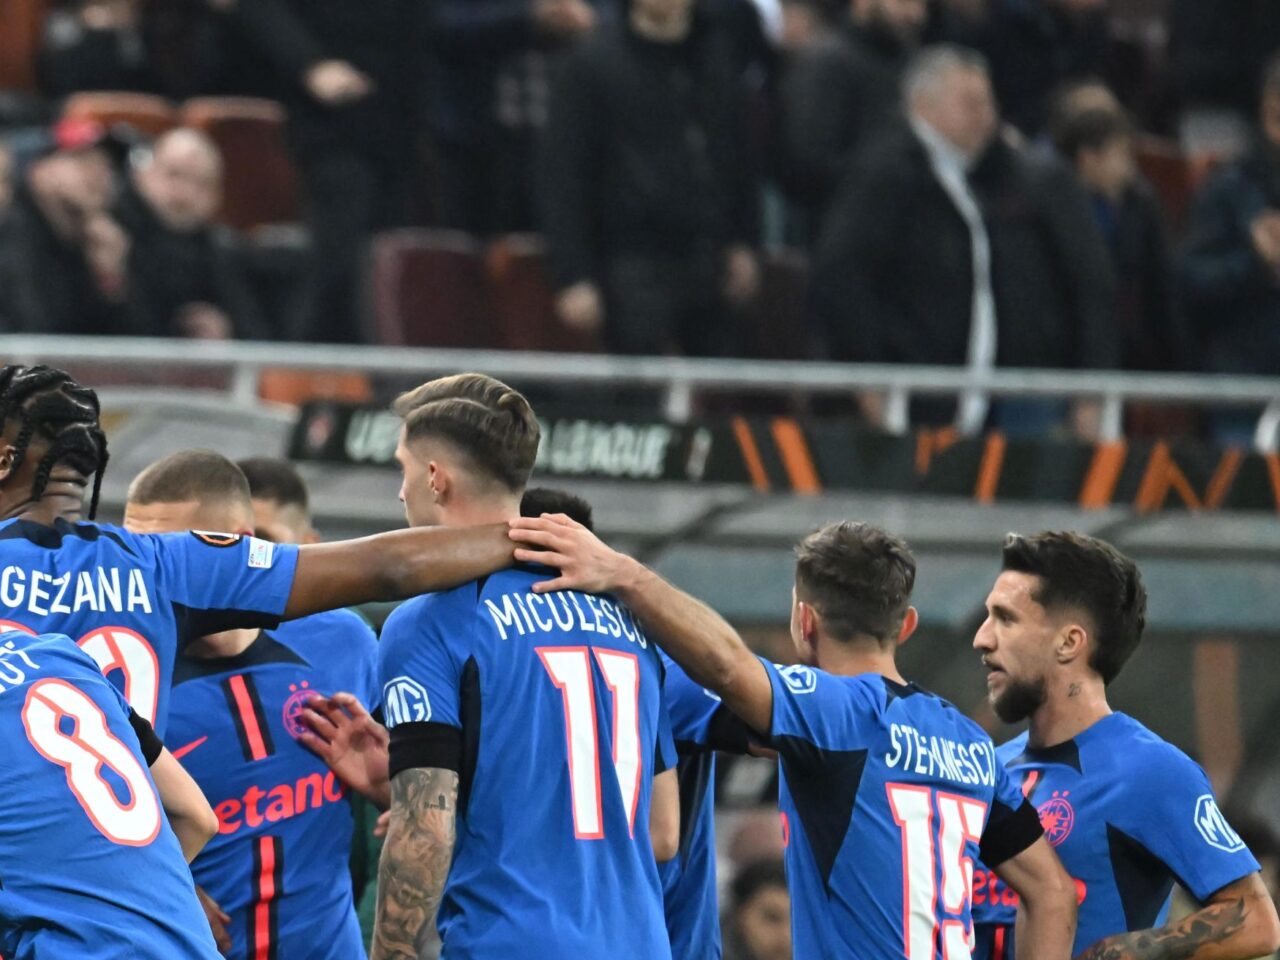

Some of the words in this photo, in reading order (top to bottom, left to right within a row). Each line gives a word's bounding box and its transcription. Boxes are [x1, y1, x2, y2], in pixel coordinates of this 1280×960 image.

[22, 677, 162, 848] 8
[215, 770, 344, 834] etan
[534, 645, 641, 840] 11
